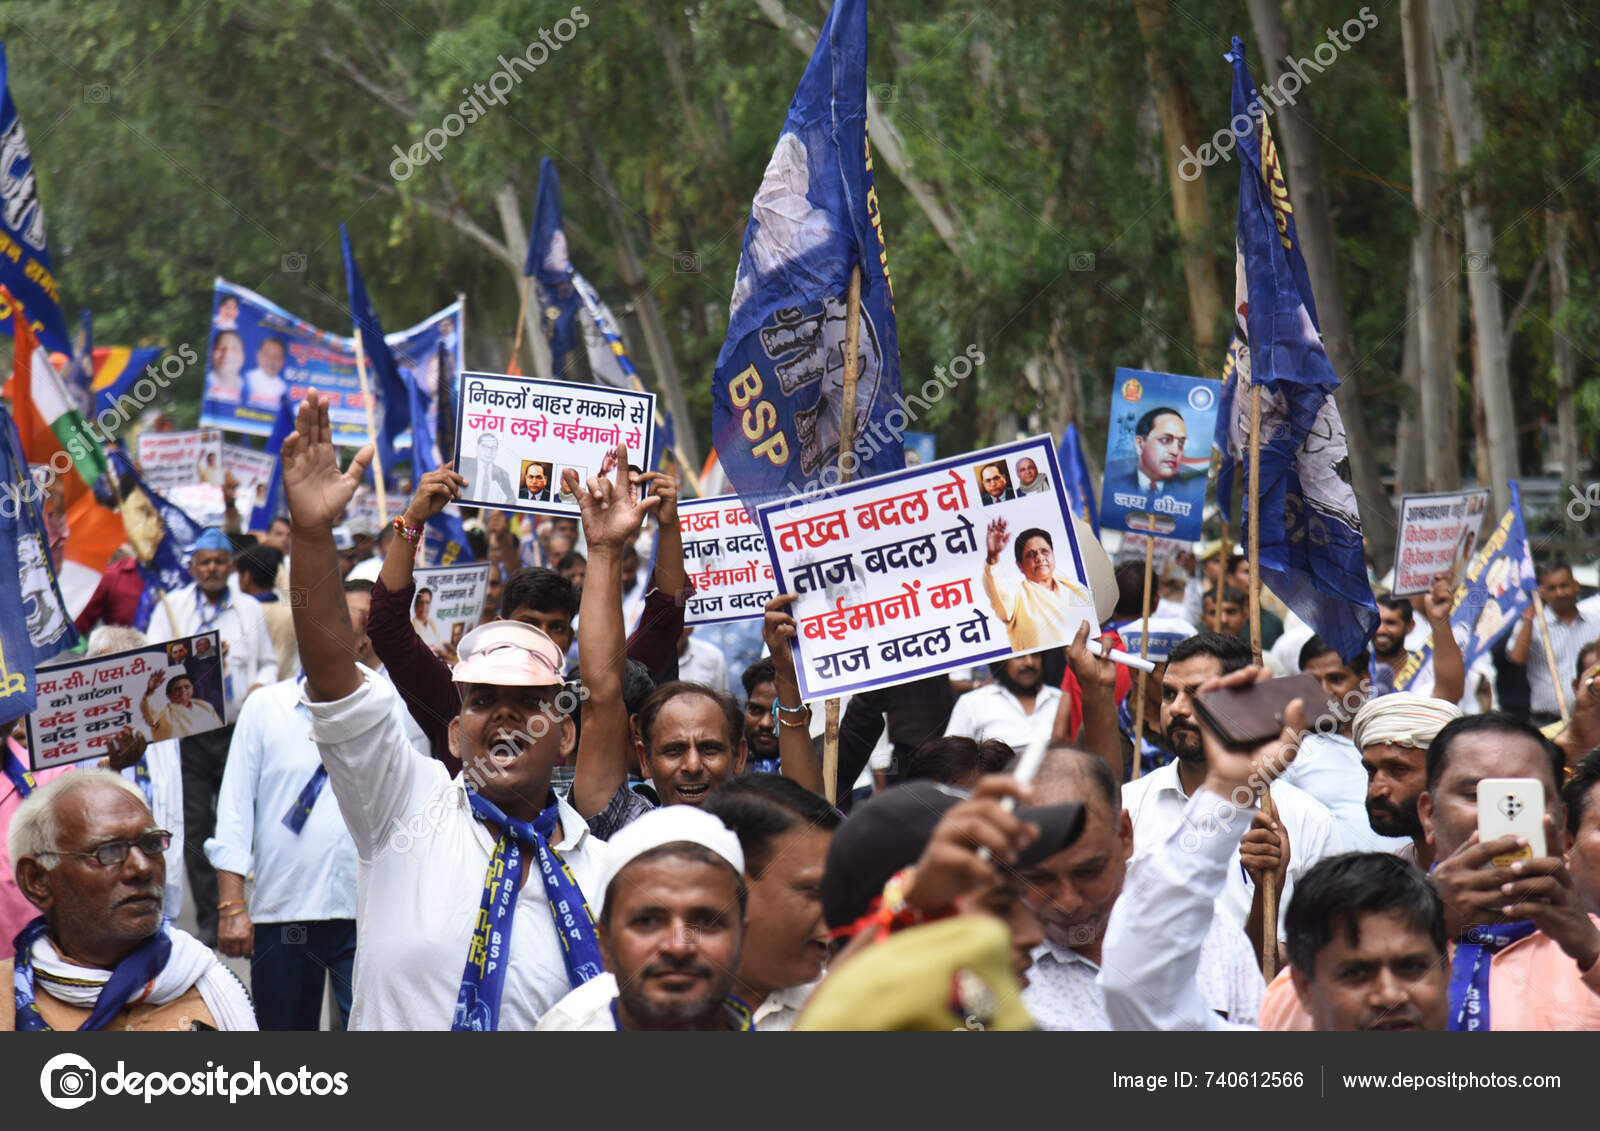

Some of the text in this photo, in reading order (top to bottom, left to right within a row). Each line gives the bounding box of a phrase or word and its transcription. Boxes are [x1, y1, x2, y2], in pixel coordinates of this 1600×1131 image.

[468, 381, 645, 424] निकलों बाहर मकाने से
[728, 362, 790, 467] BSP
[467, 409, 642, 450] जंग लड़ो बईमानो से
[679, 507, 752, 533] तख्त बद
[775, 469, 970, 552] तख्त बदल दो
[1113, 492, 1147, 509] जय
[682, 538, 720, 560] ताज
[788, 515, 978, 594] ताज बदल दो
[687, 596, 723, 615] राज
[800, 577, 974, 640] बईमानों का
[812, 609, 991, 680] राज बदल दो
[38, 696, 133, 729] बंद करो
[49, 691, 73, 709] को
[40, 711, 133, 743] बंद करो
[42, 741, 78, 760] बंद
[497, 878, 515, 919] BSP
[486, 930, 503, 976] BSP
